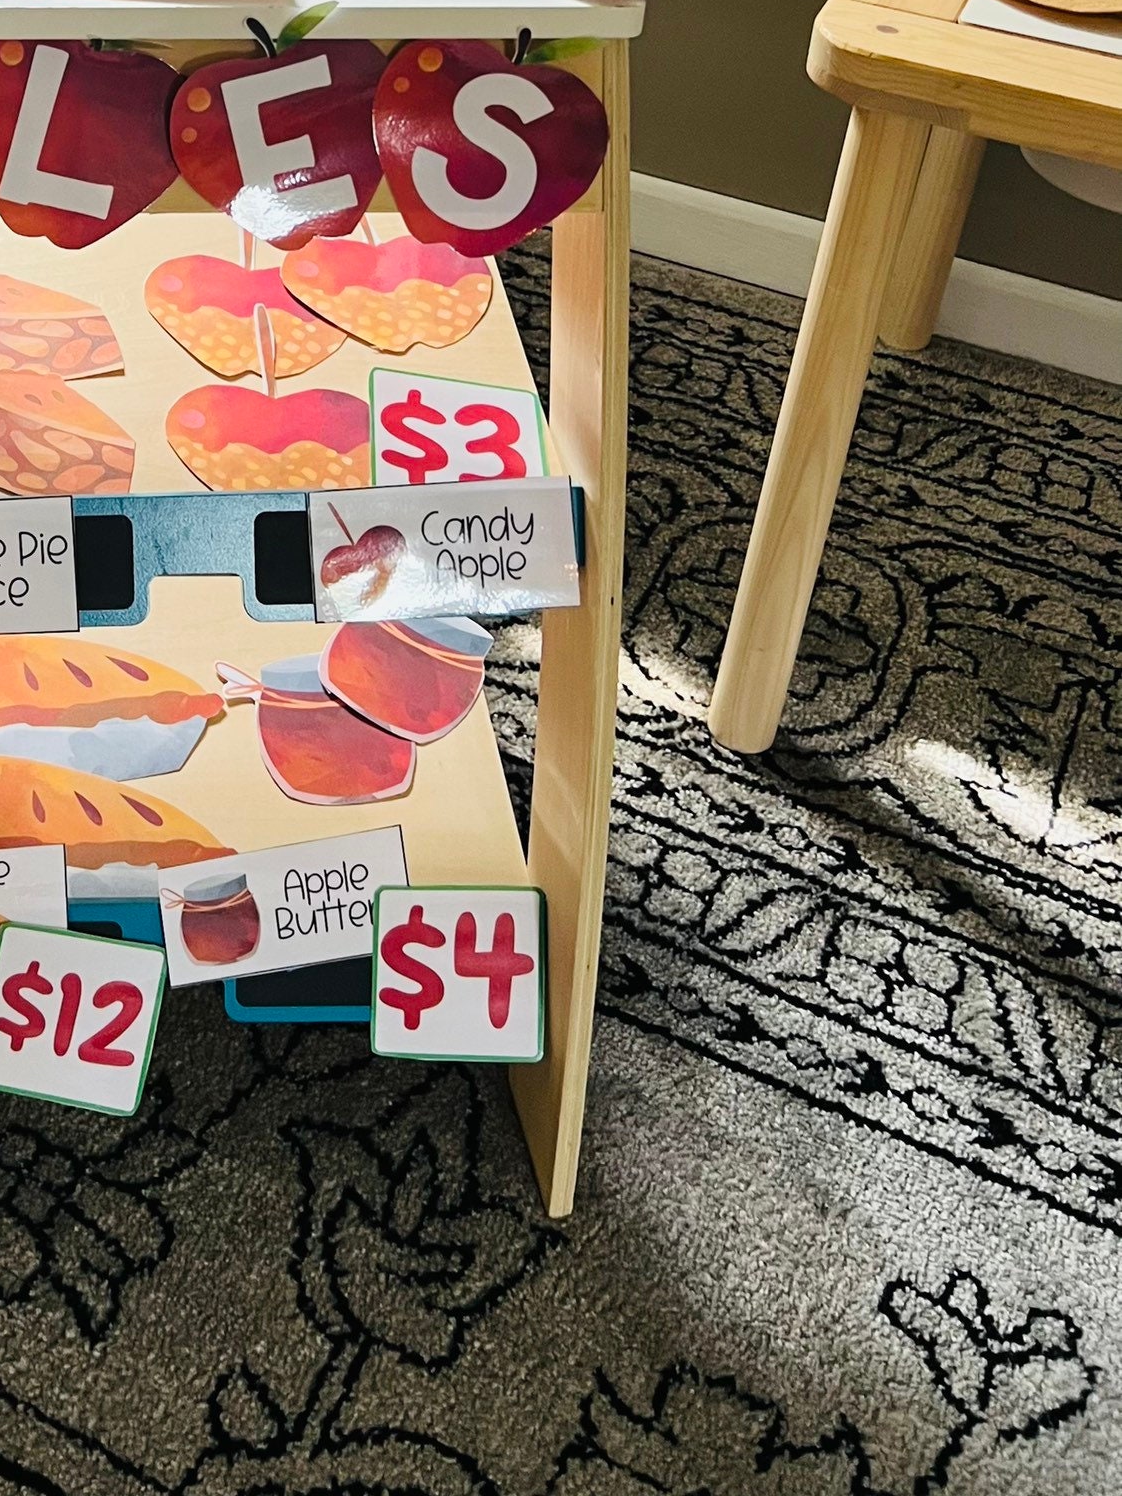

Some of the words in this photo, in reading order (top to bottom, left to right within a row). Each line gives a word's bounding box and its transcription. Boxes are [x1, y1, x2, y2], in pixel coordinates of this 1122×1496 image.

[381, 389, 528, 485] $3
[421, 506, 534, 545] Candy
[18, 531, 68, 566] Pie
[436, 546, 527, 589] Apple
[284, 861, 369, 905] Apple
[379, 905, 535, 1030] $4
